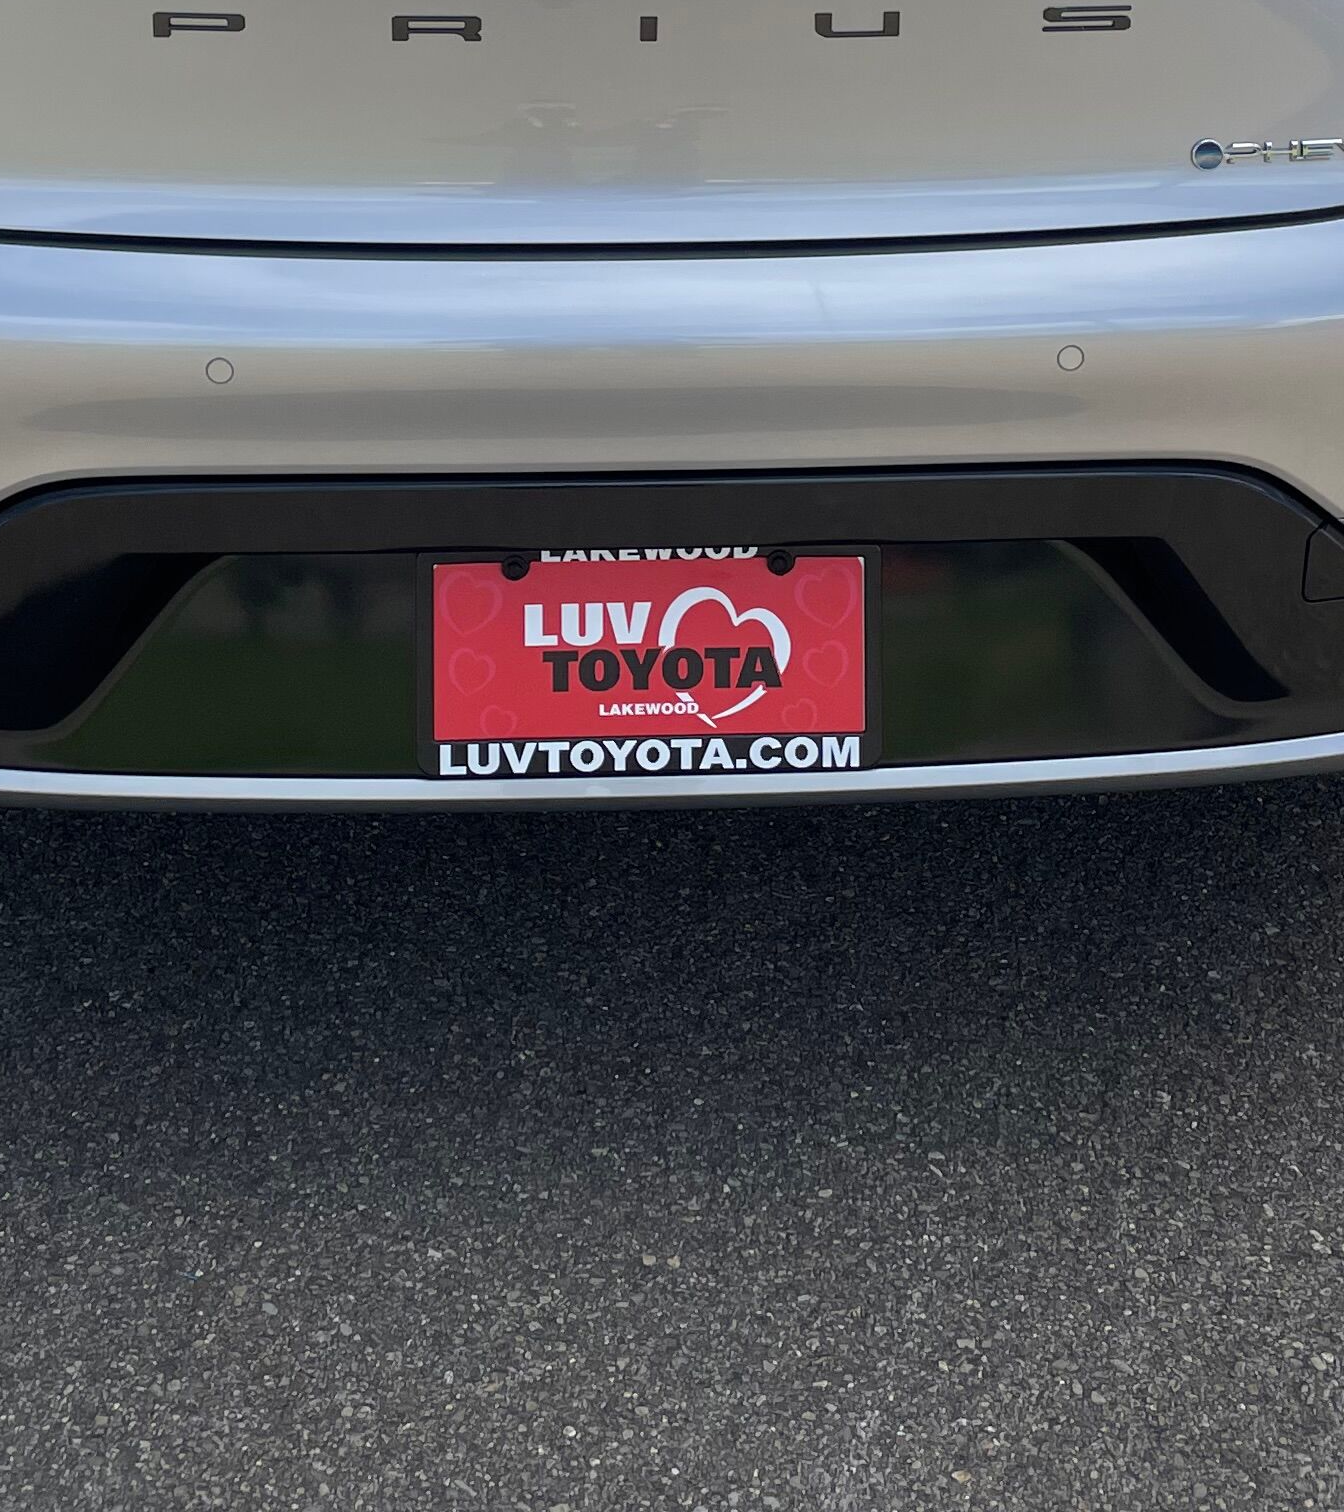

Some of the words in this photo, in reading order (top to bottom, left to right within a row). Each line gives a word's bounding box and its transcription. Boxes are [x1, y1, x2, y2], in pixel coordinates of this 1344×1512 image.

[152, 4, 1132, 43] PRIUS
[523, 601, 652, 647] LUV
[542, 646, 782, 692] TOYOTA
[598, 701, 699, 716] LAKEWOOD
[439, 736, 861, 776] LUVTOYOTA.COM
